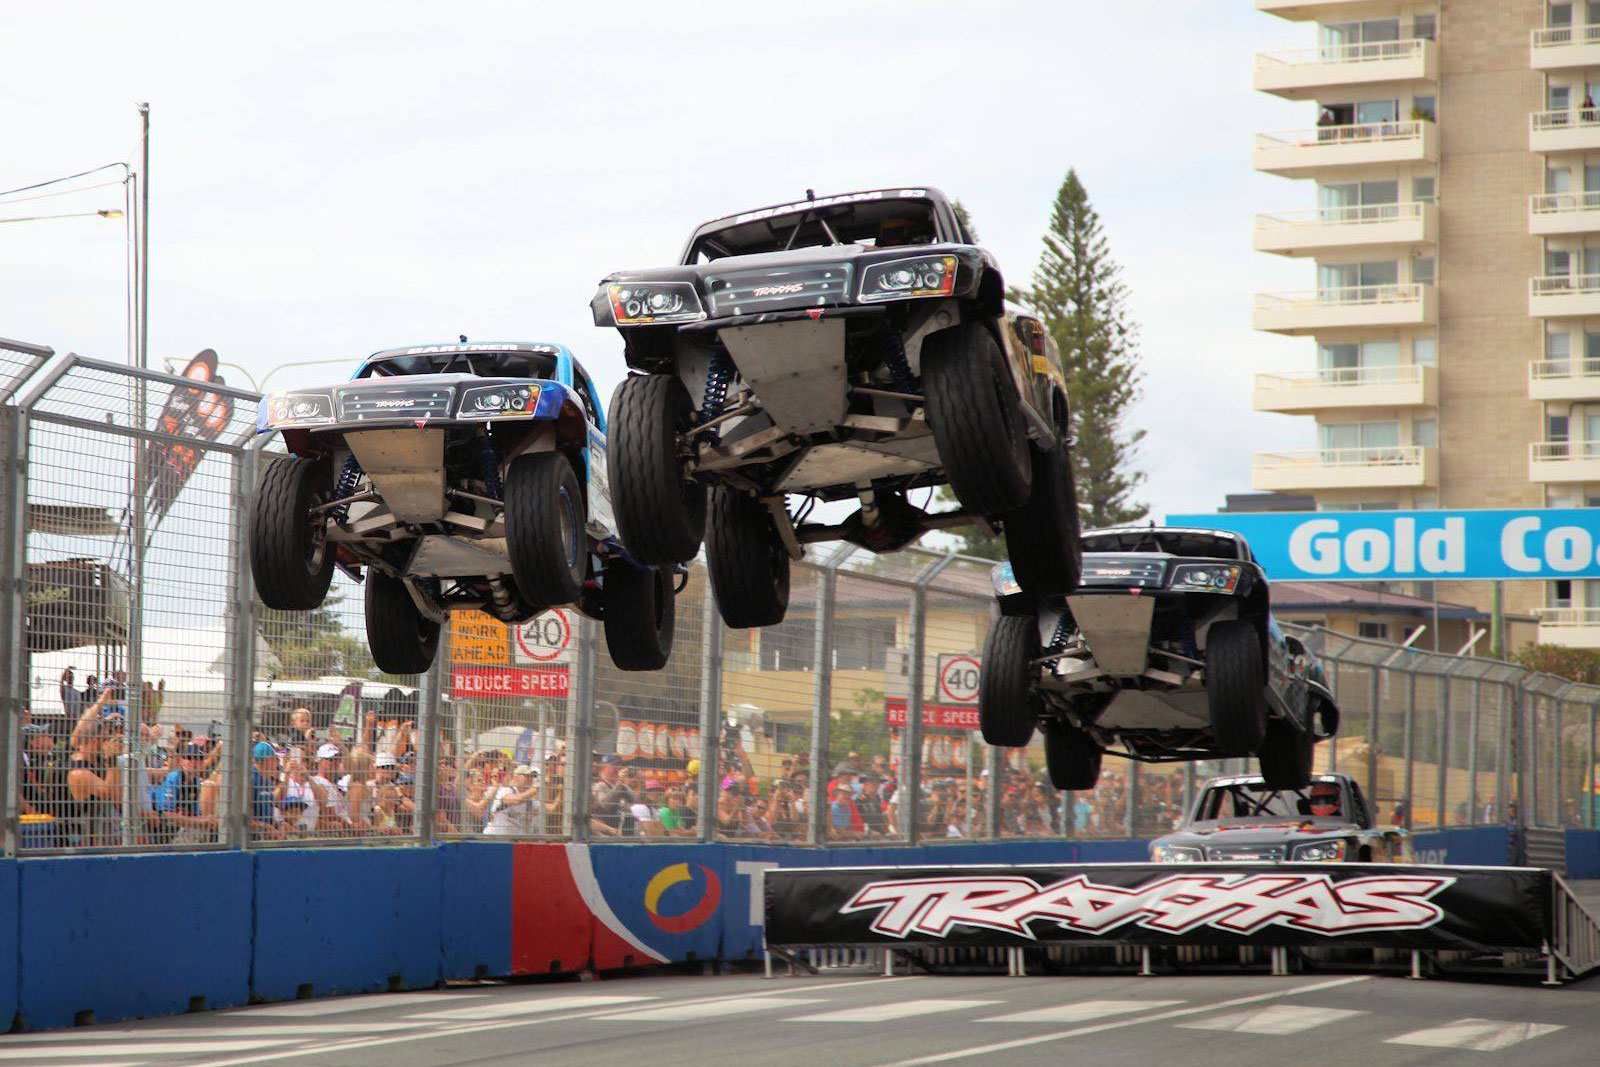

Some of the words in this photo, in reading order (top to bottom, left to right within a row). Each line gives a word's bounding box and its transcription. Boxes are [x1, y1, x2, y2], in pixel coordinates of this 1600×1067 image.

[1289, 516, 1466, 575] Gold
[1500, 515, 1600, 573] Co
[523, 618, 562, 646] 40
[453, 644, 506, 661] AHEAD
[455, 674, 513, 691] REDUCE
[521, 674, 568, 690] SPEED
[947, 668, 979, 691] 40
[888, 709, 936, 723] RECE
[838, 872, 1458, 940] TRAXXAS
